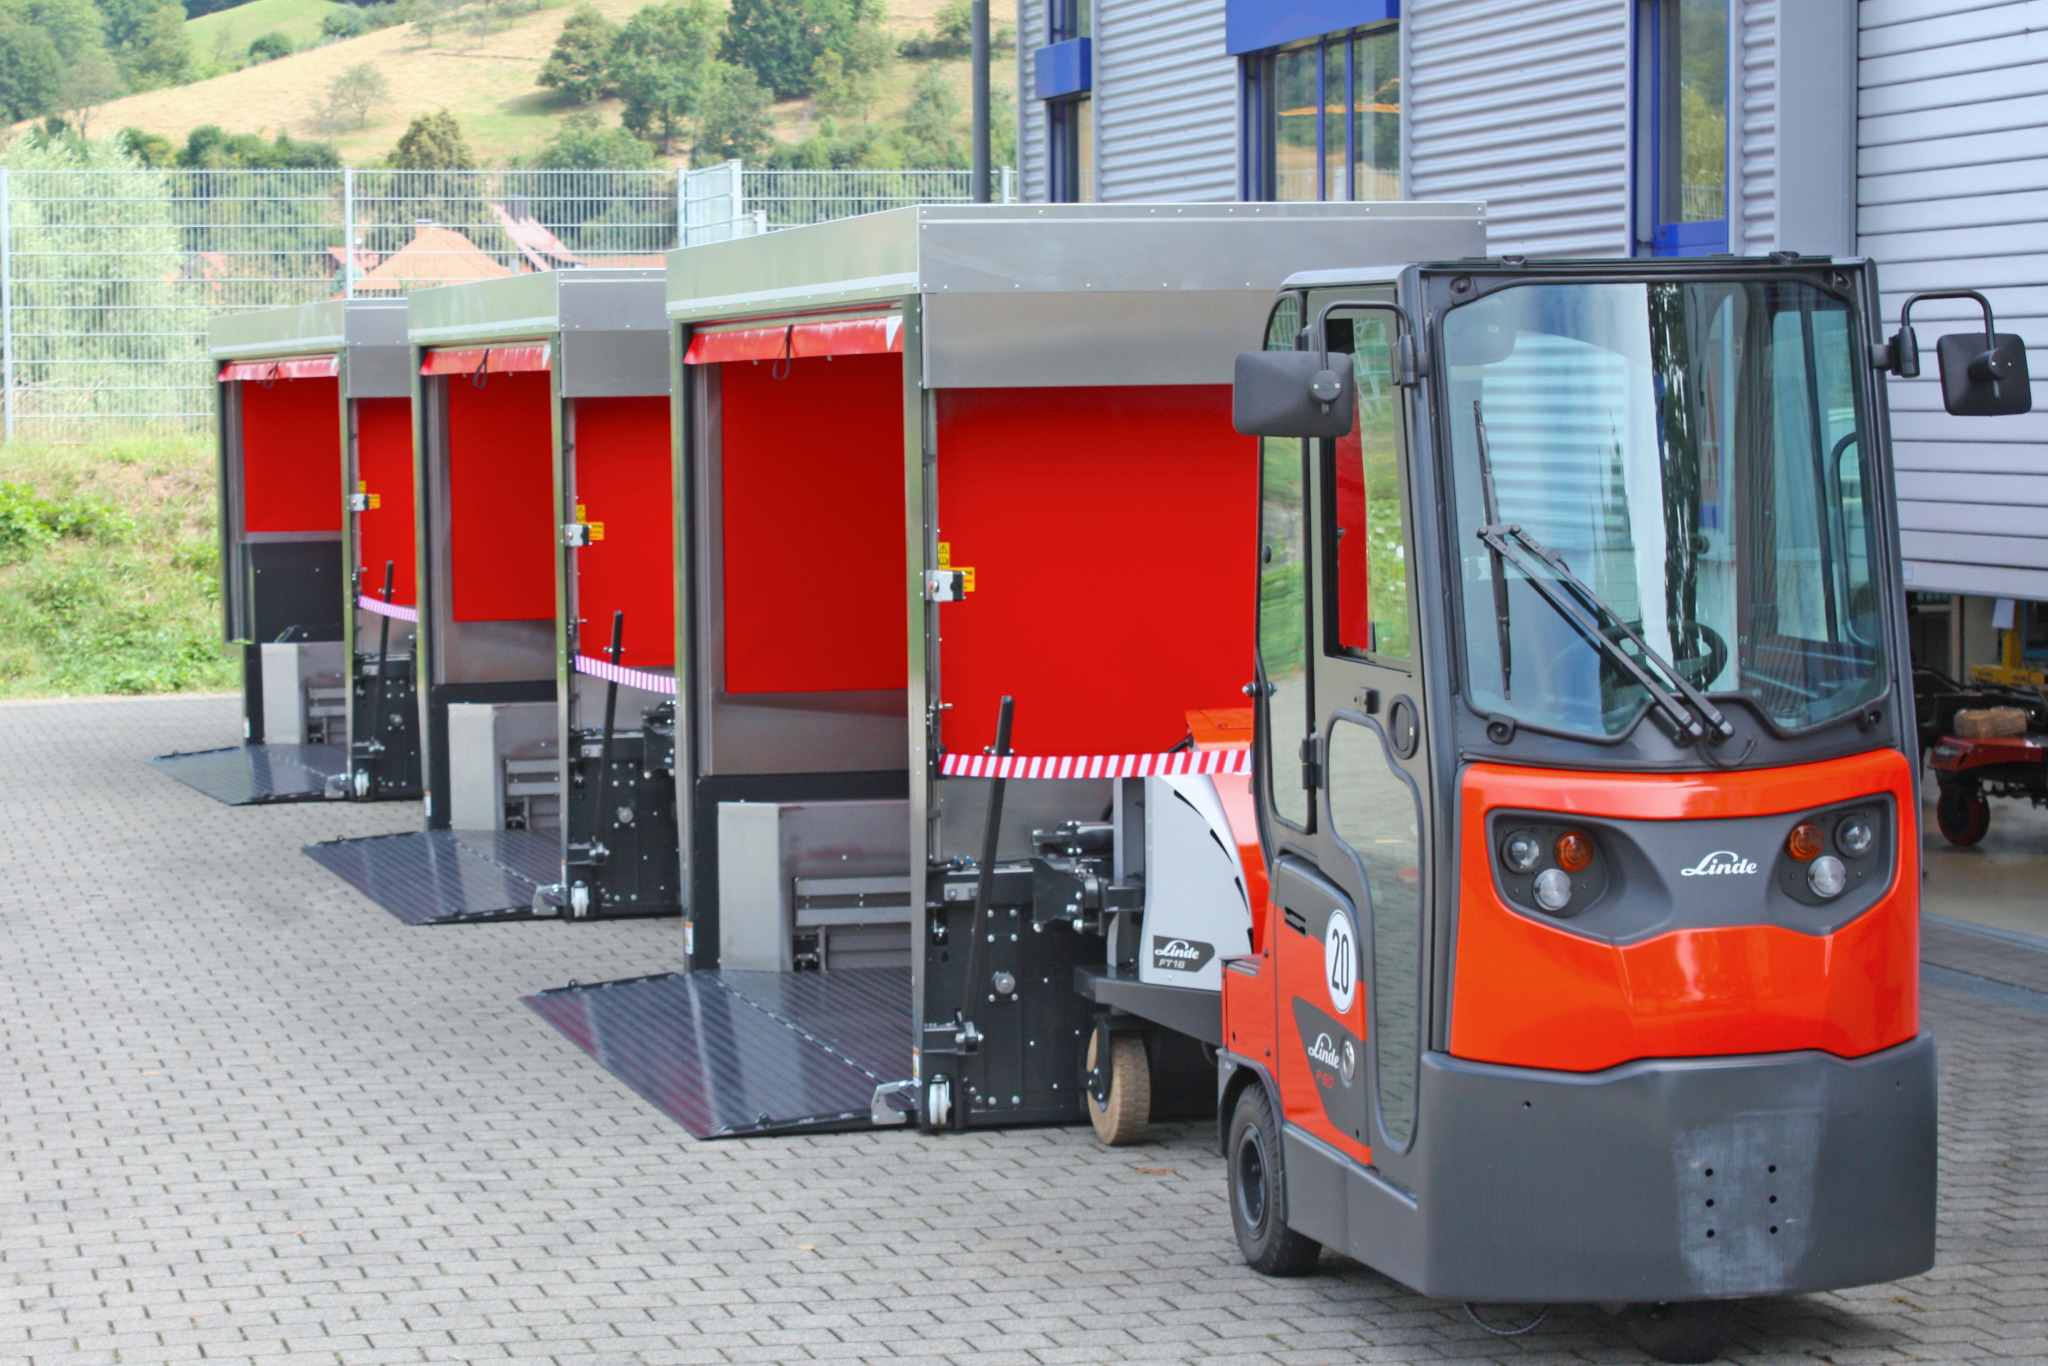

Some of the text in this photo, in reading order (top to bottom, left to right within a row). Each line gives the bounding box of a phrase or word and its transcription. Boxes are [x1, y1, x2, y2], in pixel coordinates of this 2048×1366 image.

[1680, 850, 1757, 876] Linde
[1154, 939, 1200, 960] Linde
[1332, 928, 1350, 995] 20
[1308, 1032, 1340, 1069] Linde
